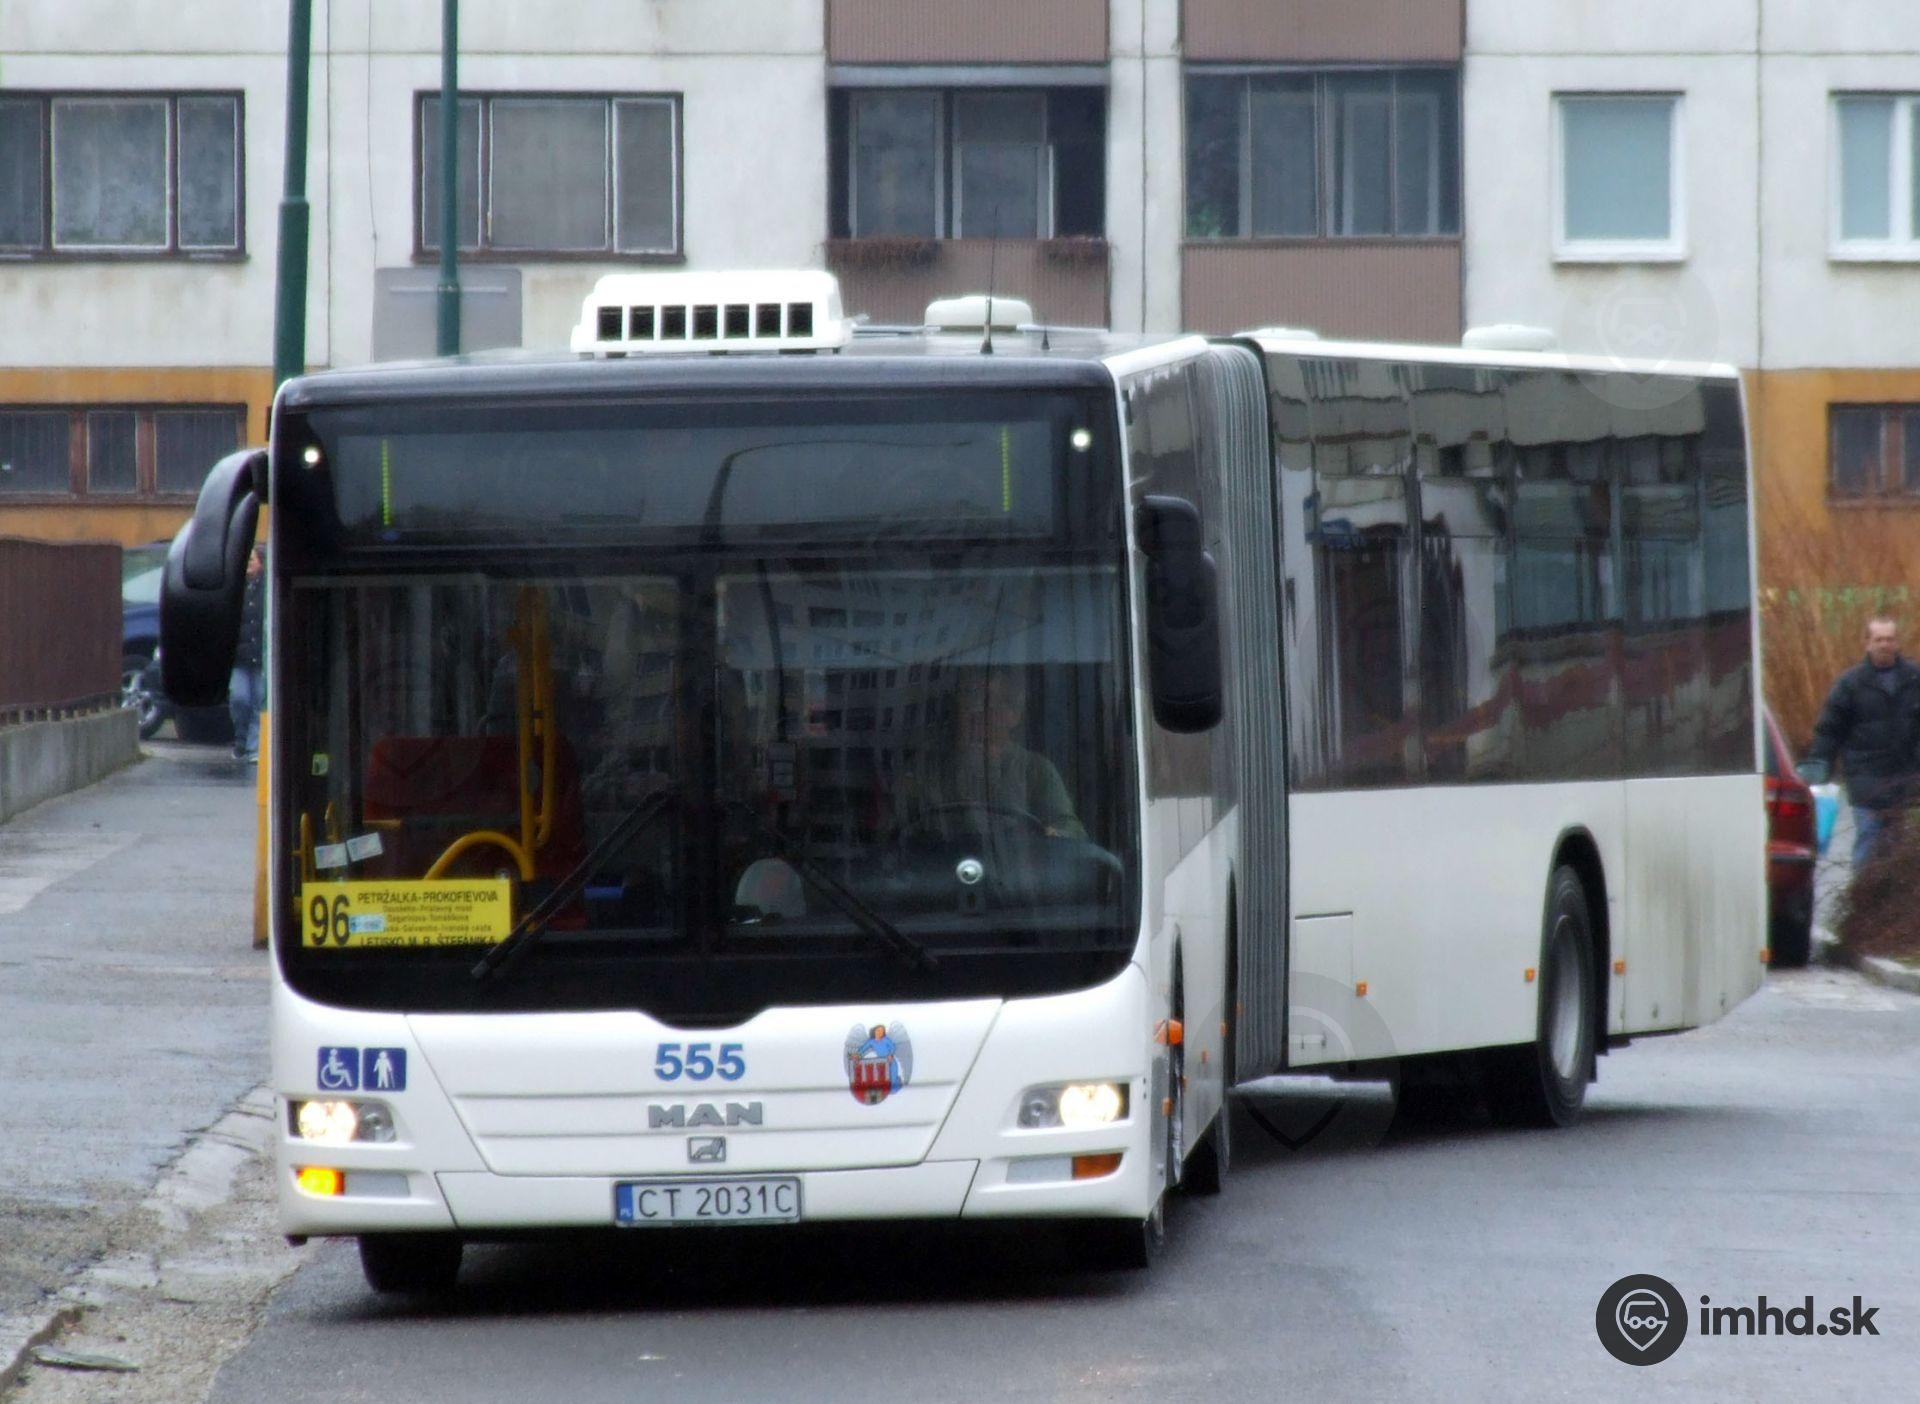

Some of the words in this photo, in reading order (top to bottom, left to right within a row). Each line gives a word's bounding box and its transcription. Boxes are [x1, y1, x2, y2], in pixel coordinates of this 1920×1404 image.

[310, 894, 351, 946] 96
[654, 1043, 746, 1081] 555
[648, 1102, 763, 1128] MAN
[638, 1188, 681, 1218] CT
[696, 1184, 792, 1216] 2031C
